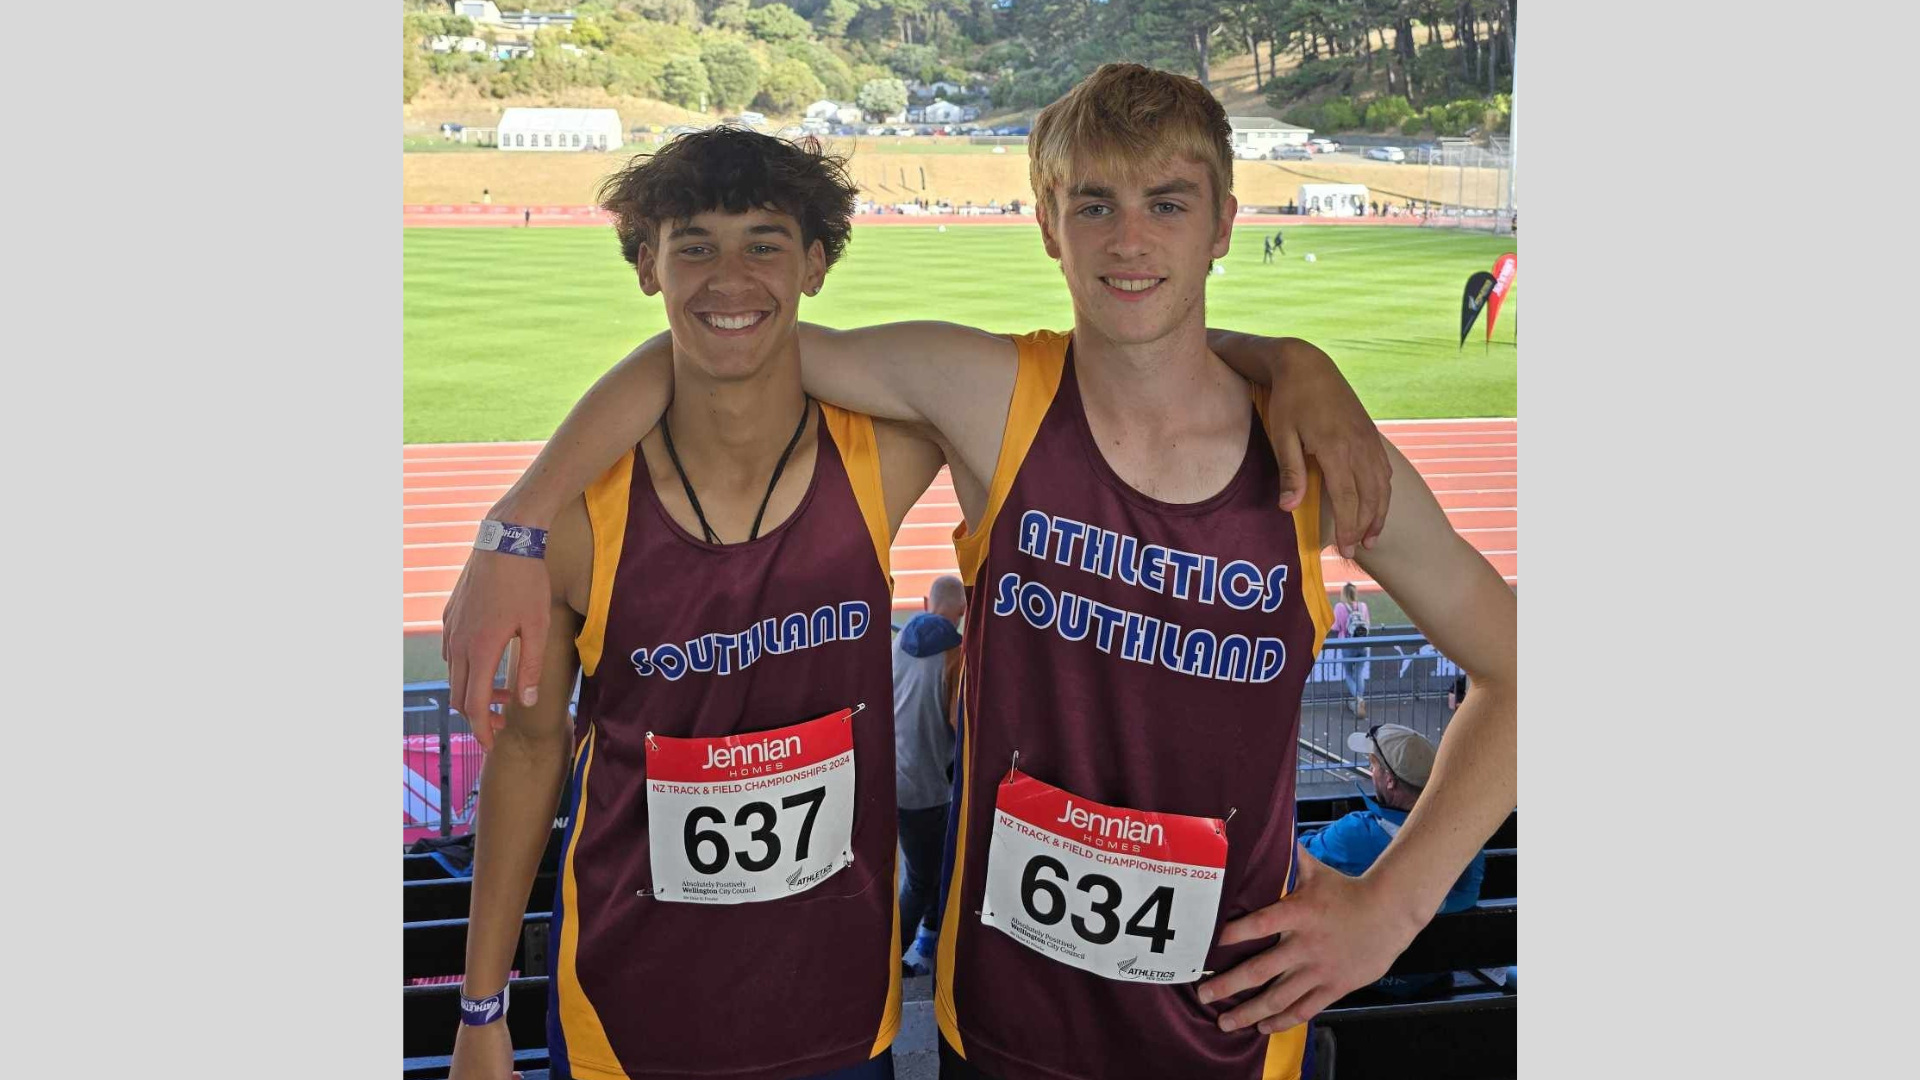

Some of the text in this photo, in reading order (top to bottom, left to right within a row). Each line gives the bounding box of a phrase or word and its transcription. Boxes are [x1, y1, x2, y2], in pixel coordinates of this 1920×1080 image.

[1018, 509, 1288, 613] ATHLETICS
[631, 600, 870, 681] SOUTHLAND
[994, 572, 1286, 683] SOUTHLAND
[702, 735, 801, 769] Jennian
[729, 762, 784, 778] HOMES
[652, 755, 850, 795] NZ TRACK & FIELD CHAMPIONSHIPS 2024
[683, 785, 826, 875] 637
[1057, 800, 1164, 846] Jennian
[999, 815, 1218, 881] NZ TRACK & FIELD CHAMPIONSHIPS 2024
[1083, 834, 1141, 853] HOMES
[682, 880, 746, 888] Absolutely Positively
[682, 886, 756, 895] Wellington City Council
[1020, 854, 1176, 954] 634
[1010, 922, 1046, 945] Wellington
[1046, 940, 1060, 952] City
[1060, 945, 1085, 960] Council
[1011, 917, 1044, 938] Absolutely
[1045, 928, 1077, 950] Positively
[1127, 968, 1176, 978] ATHLETICS
